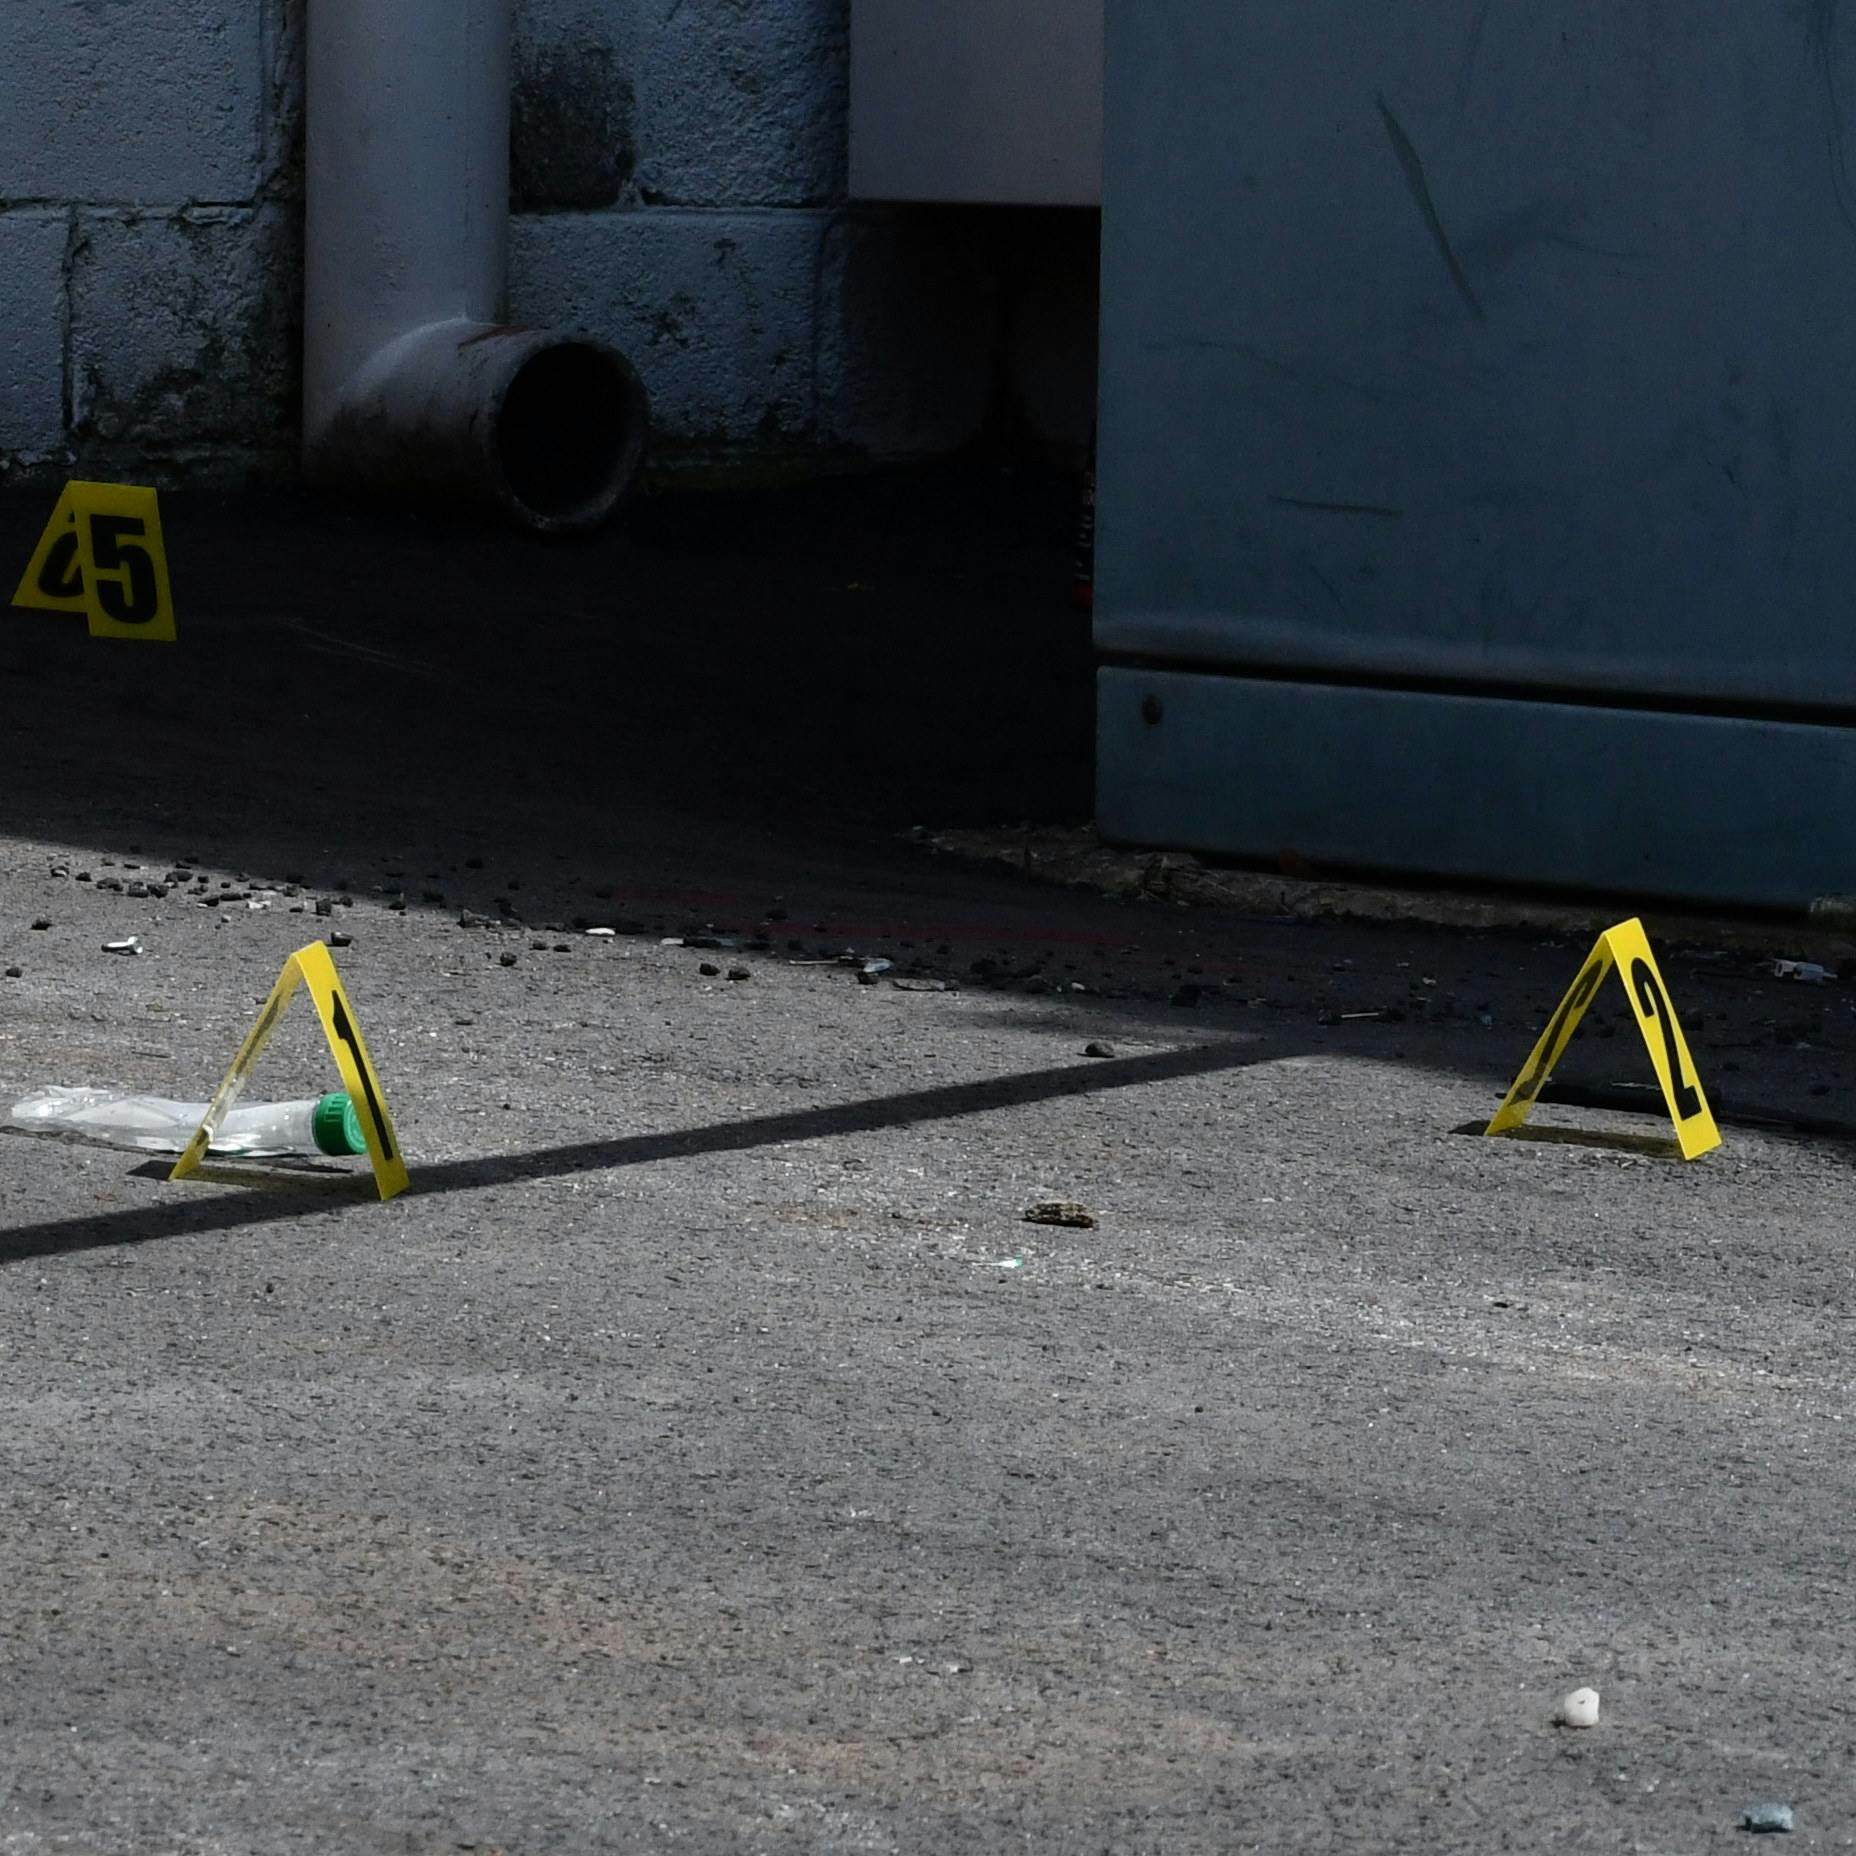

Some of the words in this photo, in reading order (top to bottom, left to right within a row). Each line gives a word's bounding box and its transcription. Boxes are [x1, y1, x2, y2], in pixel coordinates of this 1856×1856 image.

[89, 514, 158, 624] 5
[332, 990, 393, 1161] 1
[1631, 957, 1702, 1120] 2
